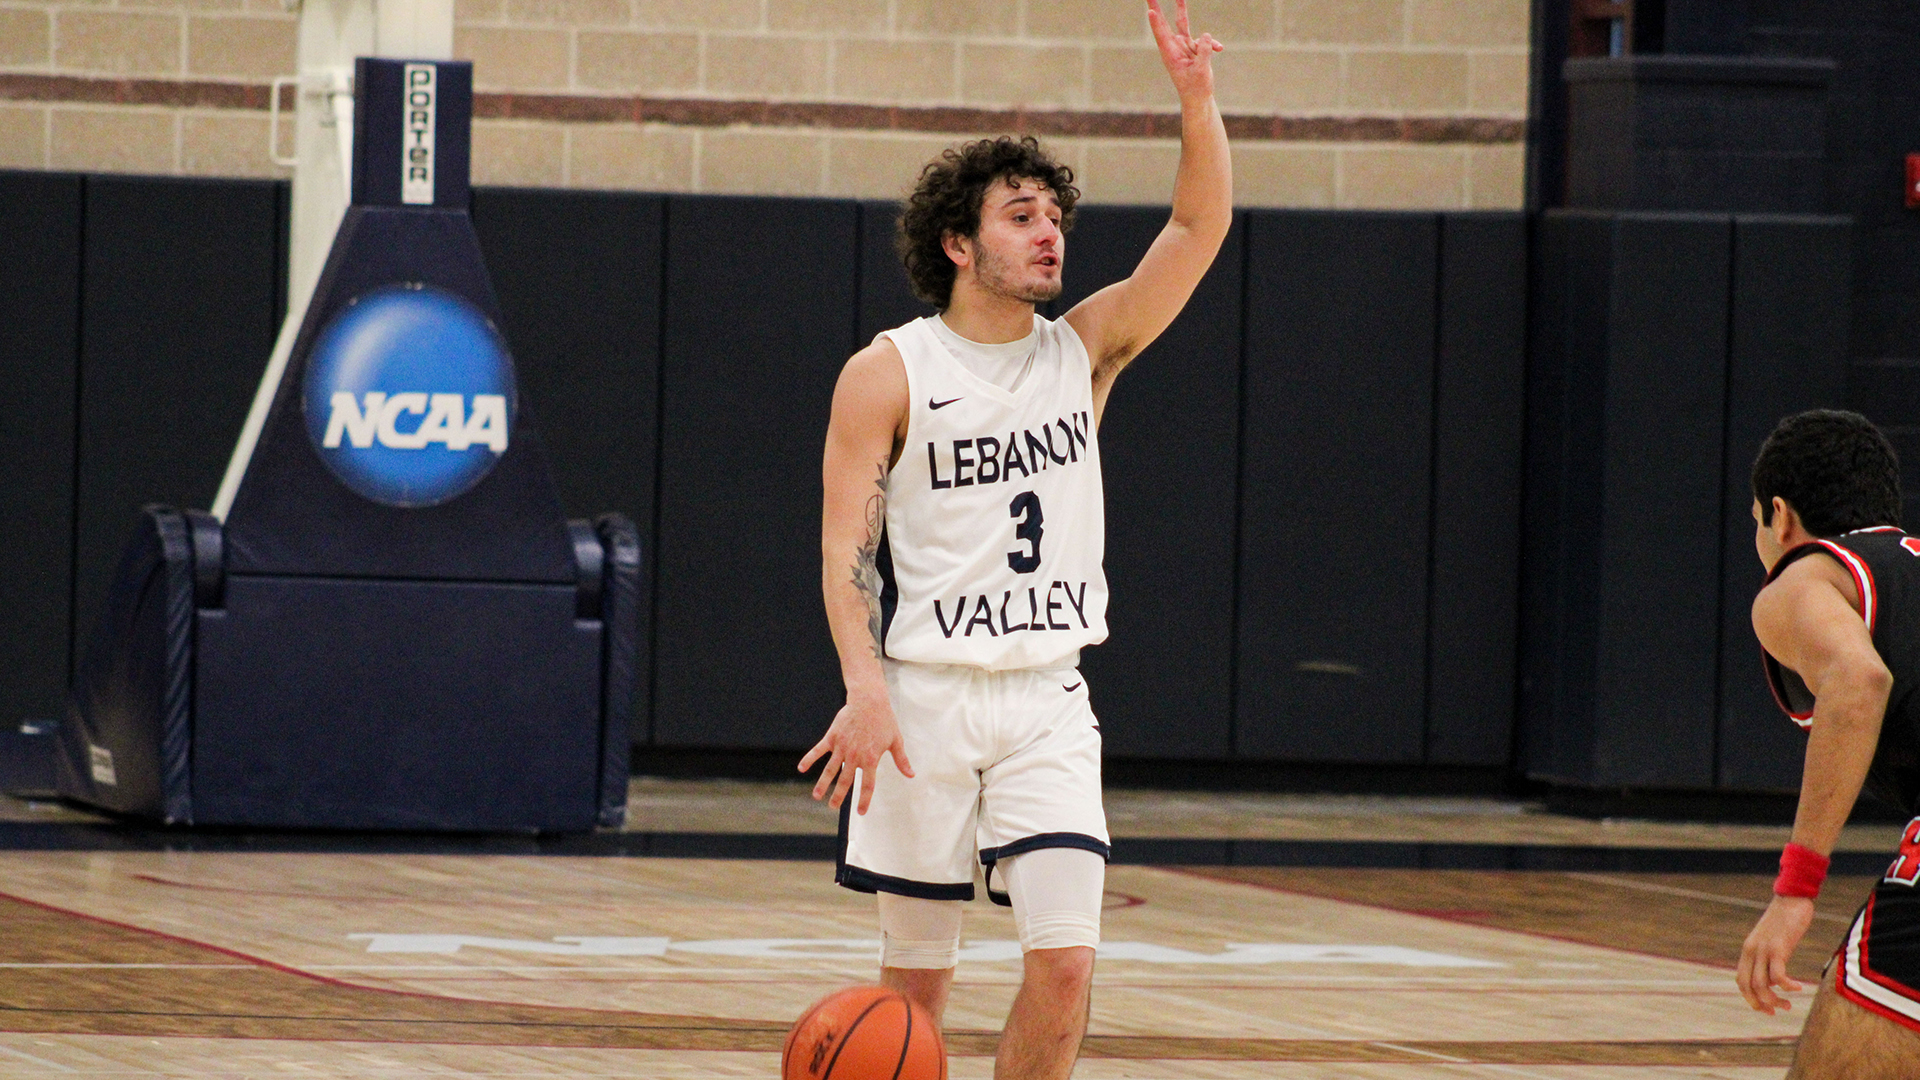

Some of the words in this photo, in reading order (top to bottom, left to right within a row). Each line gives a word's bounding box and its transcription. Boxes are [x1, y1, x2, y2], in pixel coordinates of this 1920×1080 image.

[409, 69, 430, 182] PORTER
[322, 391, 509, 453] NCAA
[927, 410, 1089, 490] LEBANON
[1006, 490, 1045, 575] 3
[933, 580, 1090, 639] VALLEY
